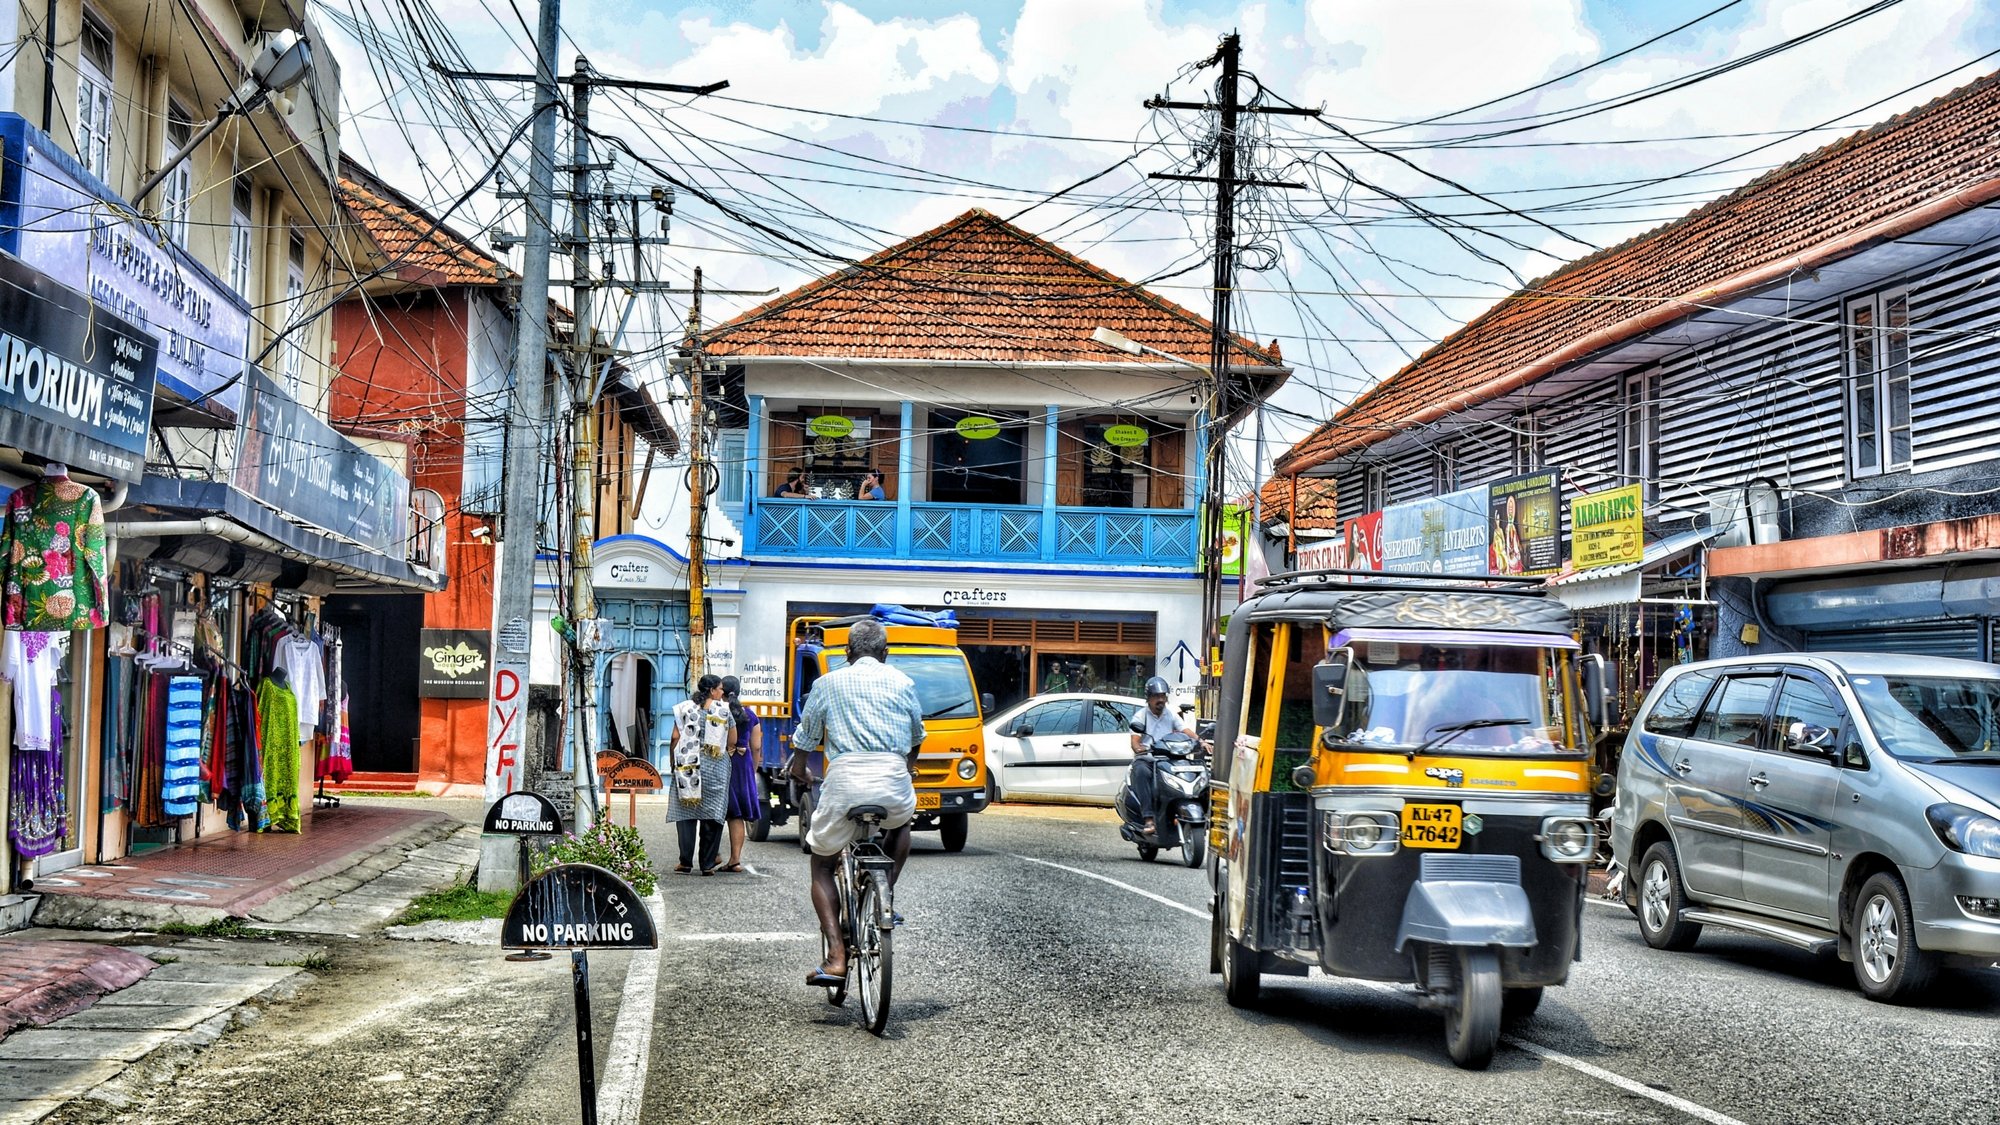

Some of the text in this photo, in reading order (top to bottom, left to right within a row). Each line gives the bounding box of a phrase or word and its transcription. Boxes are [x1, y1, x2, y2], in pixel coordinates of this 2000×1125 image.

[115, 233, 150, 287] PEPPER
[151, 262, 160, 292] &
[186, 287, 212, 328] TRADE
[1576, 495, 1635, 528] AKBAR ARTS
[1443, 525, 1485, 552] ANTIQARTS
[610, 561, 649, 578] Crafters
[943, 587, 1007, 605] Crafters
[434, 651, 479, 667] Ginger
[740, 676, 775, 684] Furniture
[609, 762, 630, 779] Crafts
[631, 761, 656, 777] Bazaar
[1425, 767, 1463, 779] ape
[613, 779, 654, 787] NO PARKING
[495, 820, 554, 831] NO PARKING
[522, 922, 634, 942] NO PARKING
